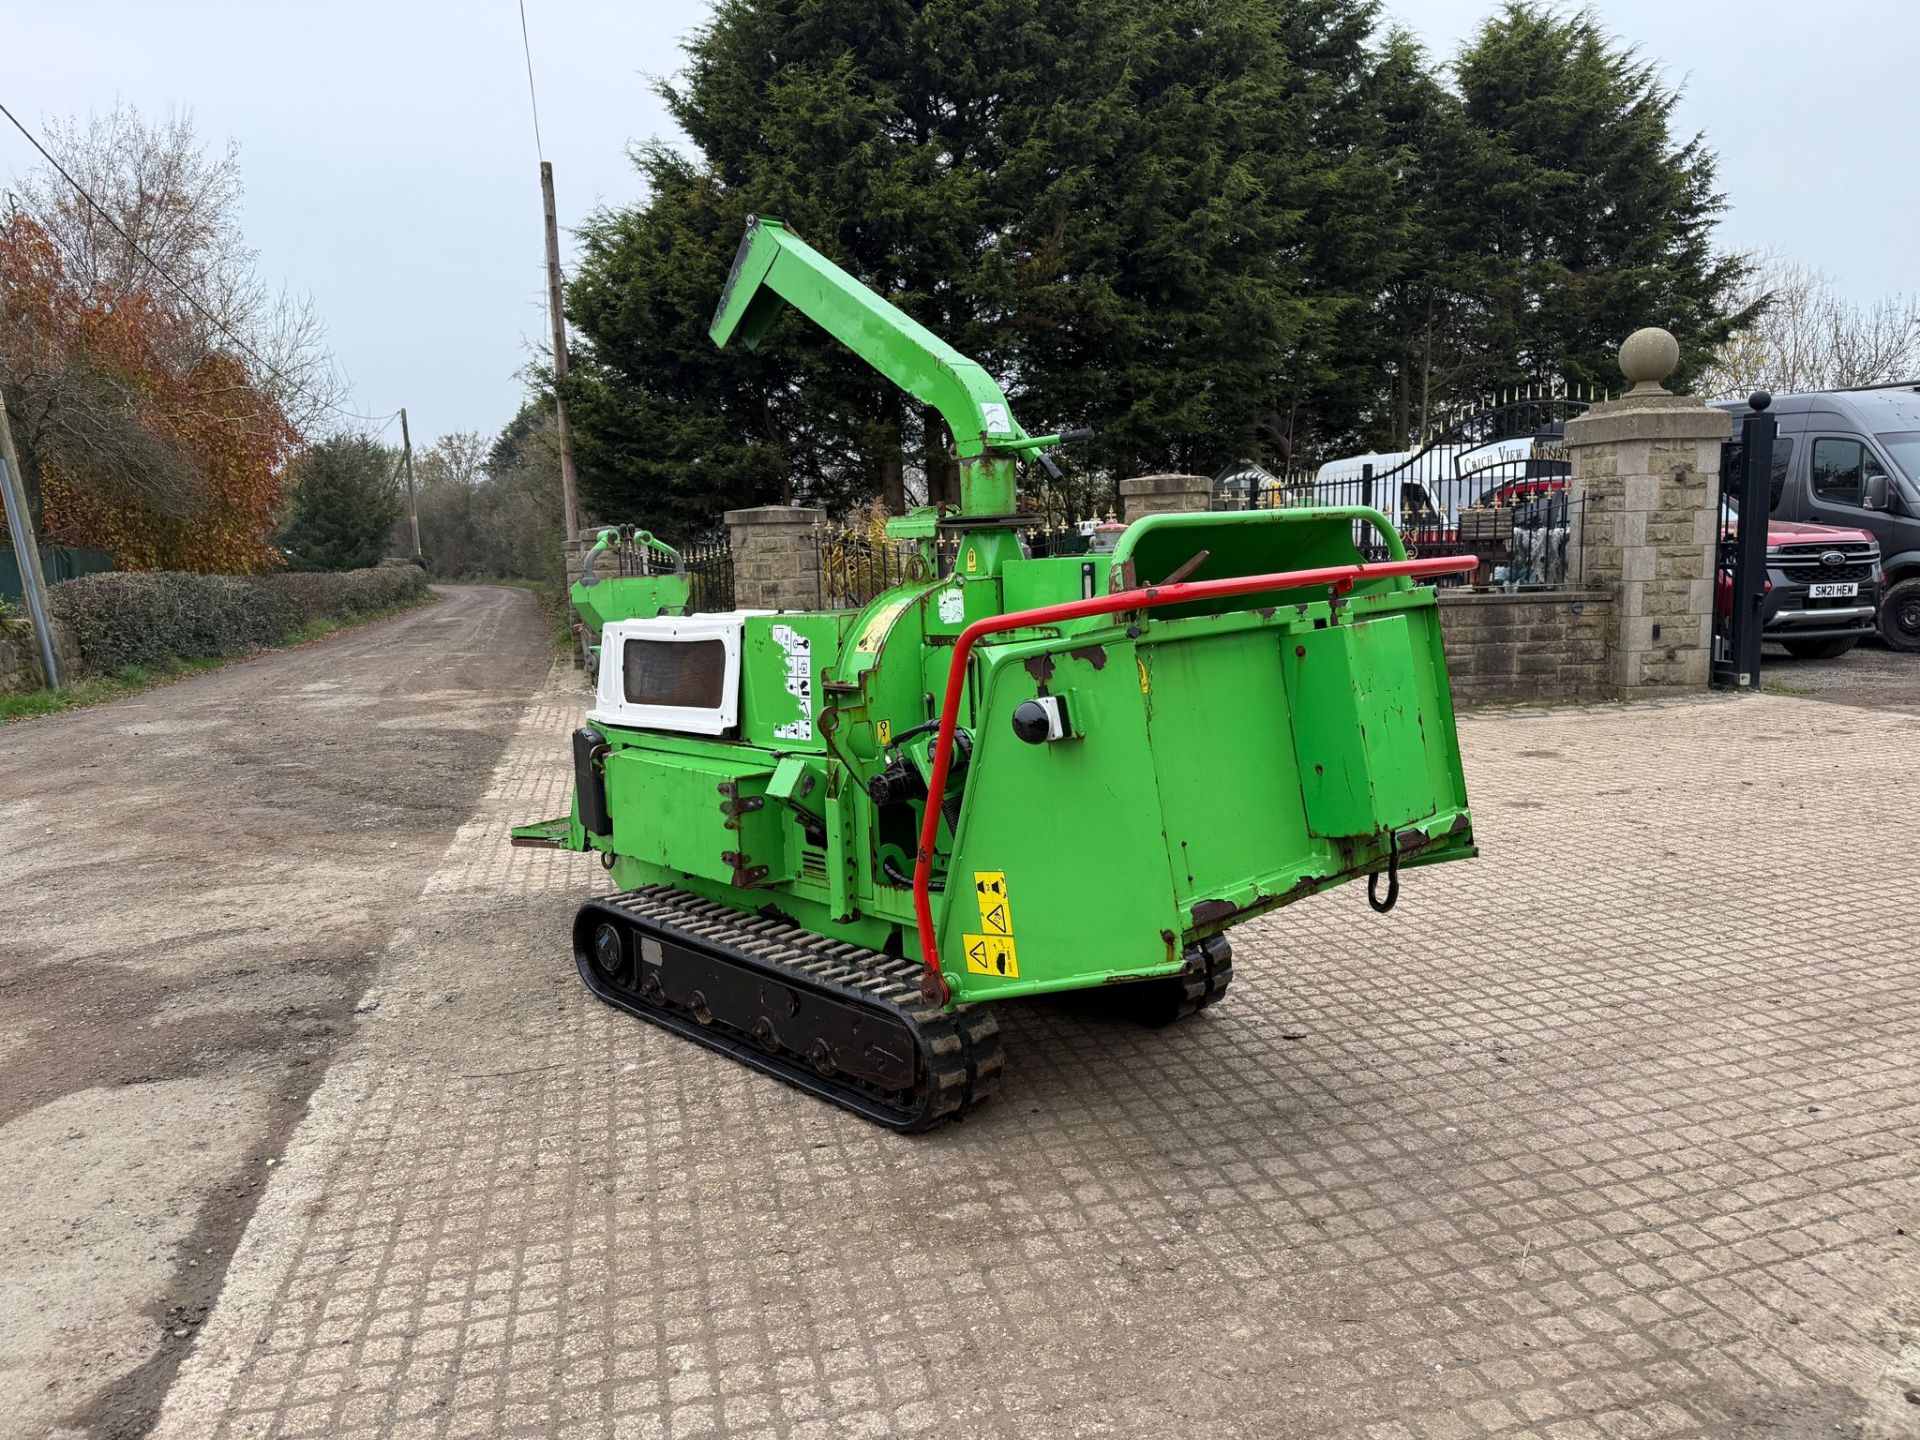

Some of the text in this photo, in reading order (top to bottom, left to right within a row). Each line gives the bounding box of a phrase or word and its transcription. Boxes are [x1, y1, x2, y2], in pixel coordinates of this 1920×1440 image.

[1498, 445, 1523, 463] VIEW
[1530, 441, 1569, 461] NURSER
[1815, 584, 1854, 596] SM21 HEM
